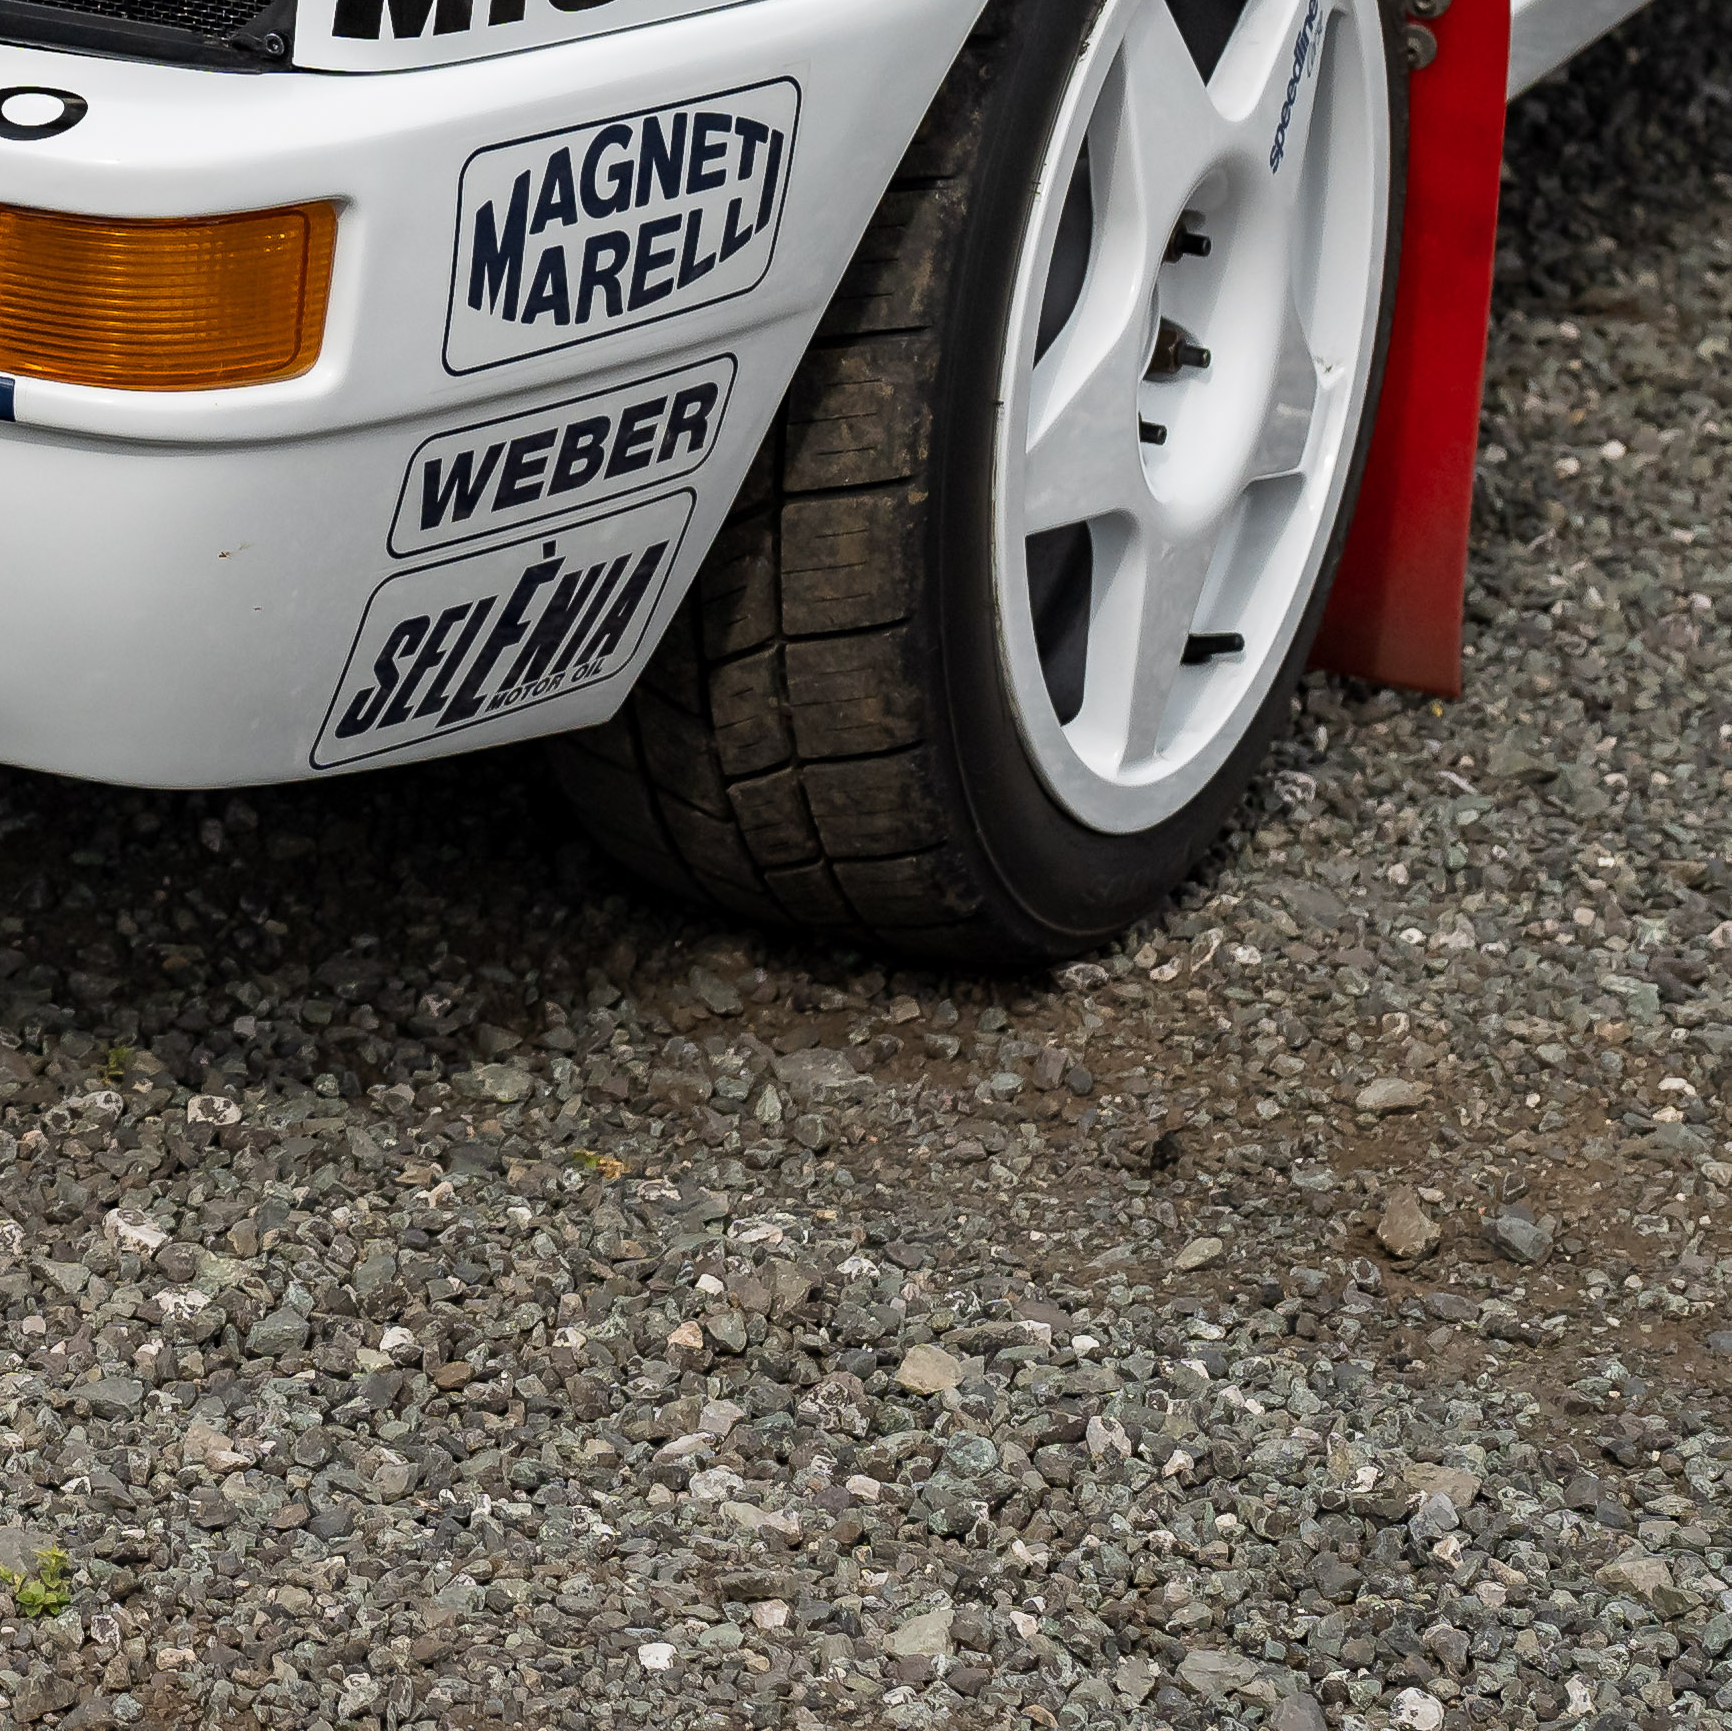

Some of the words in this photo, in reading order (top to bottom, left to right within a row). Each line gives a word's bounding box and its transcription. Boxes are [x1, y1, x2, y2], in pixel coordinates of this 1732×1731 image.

[472, 112, 784, 253] MAGNETI
[467, 188, 777, 326] MARELLI
[419, 380, 722, 530] WEBER
[484, 672, 566, 713] MOTOR
[570, 659, 608, 683] OIL
